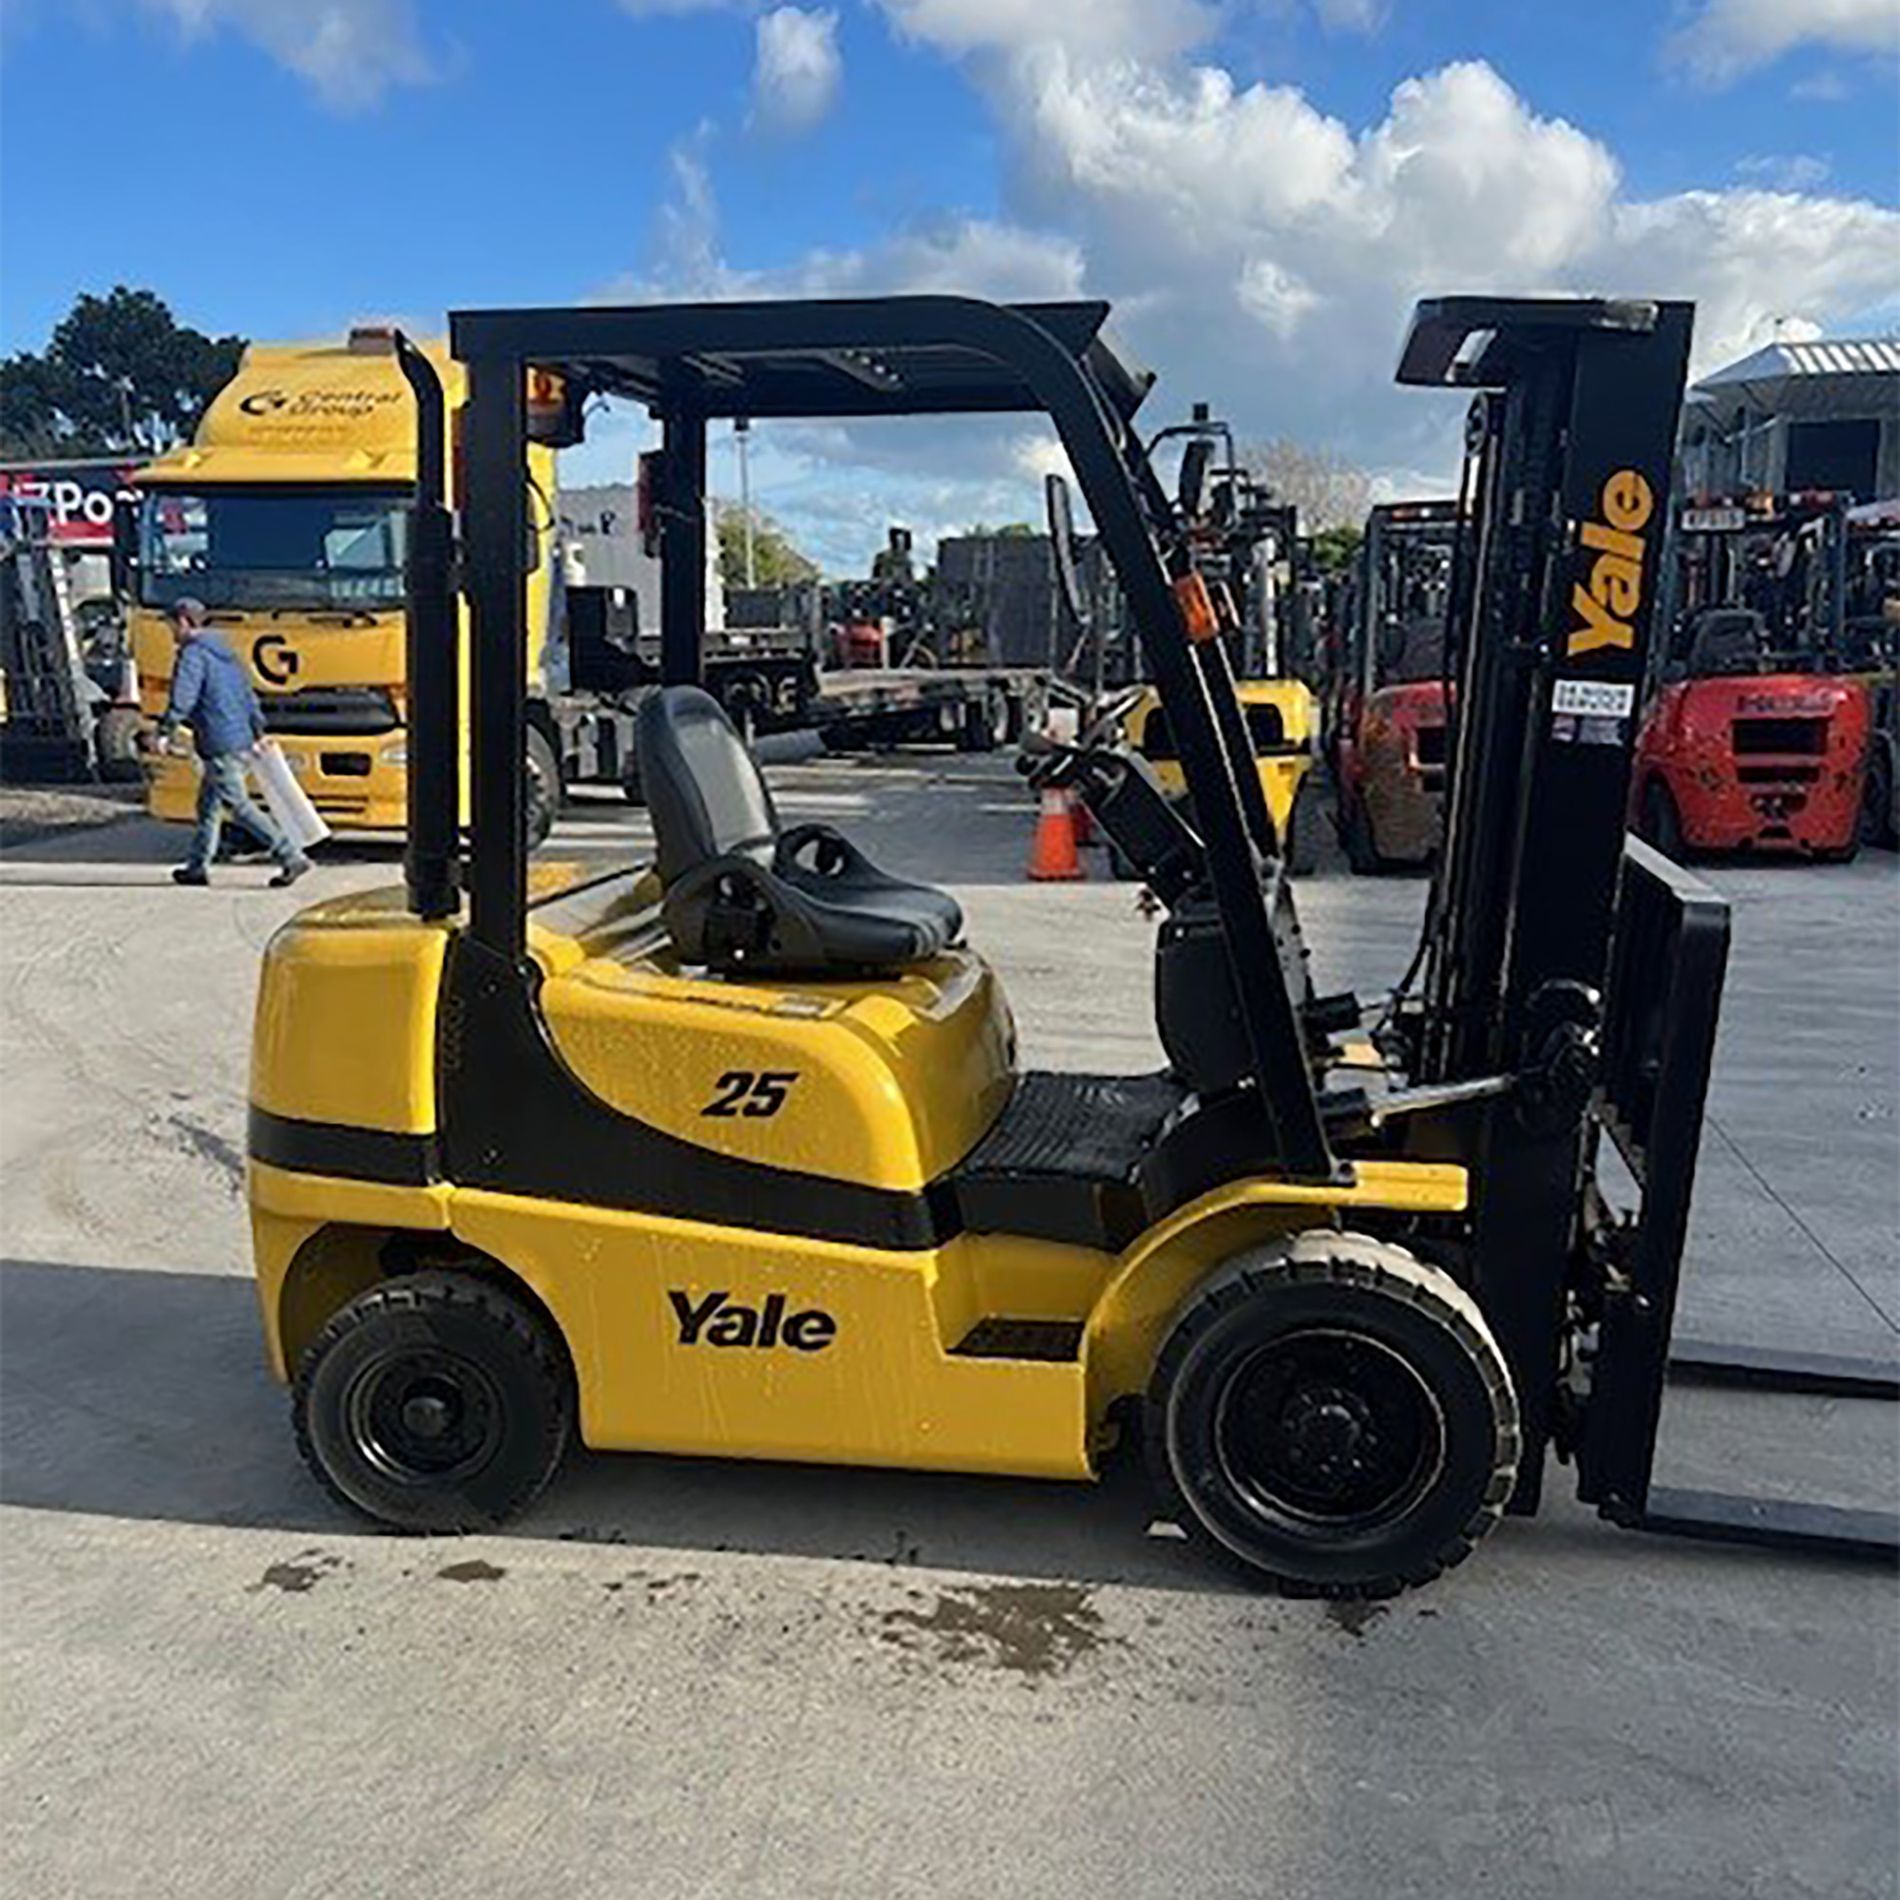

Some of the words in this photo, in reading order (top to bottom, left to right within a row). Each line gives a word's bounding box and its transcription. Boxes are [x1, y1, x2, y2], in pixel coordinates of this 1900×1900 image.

[289, 400, 374, 418] Group
[1567, 469, 1655, 657] Yale
[252, 635, 299, 685] G
[700, 1071, 801, 1117] 25
[667, 1290, 837, 1351] Yale
